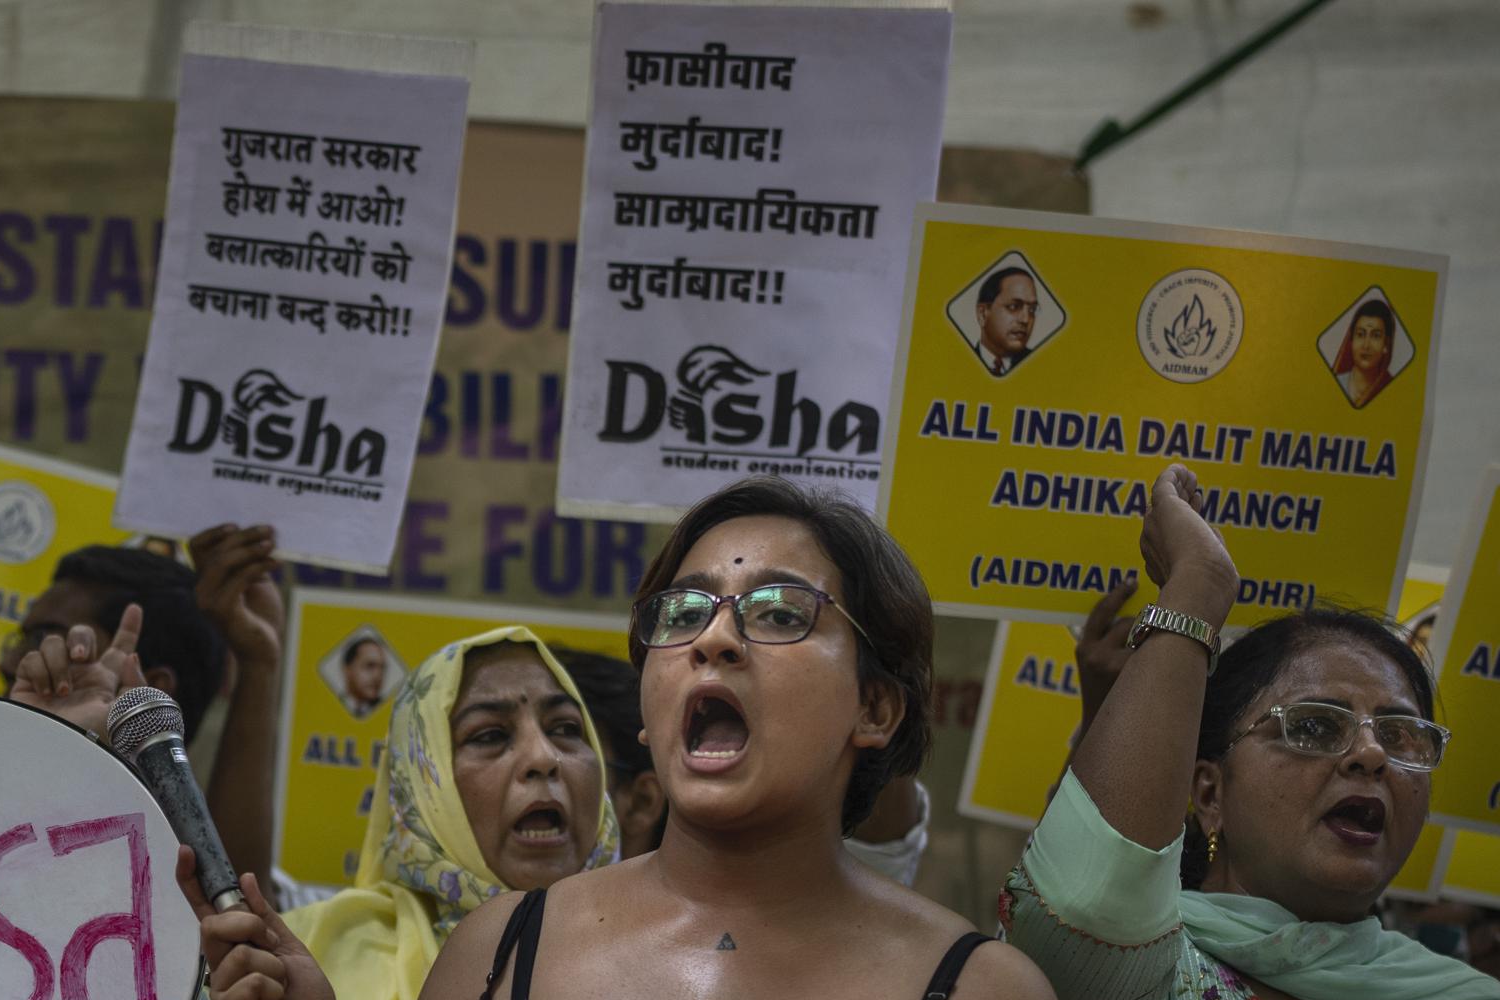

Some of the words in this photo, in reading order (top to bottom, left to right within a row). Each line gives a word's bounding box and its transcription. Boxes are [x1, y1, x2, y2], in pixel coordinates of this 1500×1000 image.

[626, 42, 795, 91] फ़ासीवाद
[221, 128, 316, 168] गुजरात
[323, 137, 421, 173] सरकार
[620, 117, 783, 171] मुर्दाबाद!
[223, 172, 280, 215] होश
[287, 177, 311, 217] में
[318, 187, 404, 226] आओ!
[614, 189, 879, 239] साम्प्रदायिकता
[205, 232, 365, 277] बलात्कारियों
[372, 242, 411, 282] को
[607, 257, 785, 310] मुर्दाबाद!!
[189, 285, 269, 320] बचाना
[277, 296, 328, 333] बन्द
[336, 295, 411, 336] करो!!
[167, 370, 386, 477] Disha
[597, 345, 880, 456] Disha
[921, 402, 998, 441] ALL
[1012, 409, 1125, 453] INDIA
[1138, 420, 1252, 463] DALIT
[1261, 431, 1397, 478] MAHILA
[662, 453, 739, 472] student
[748, 459, 880, 481] organisation
[992, 472, 1150, 517] ADHIKA
[1198, 489, 1321, 533] MANCH
[483, 504, 644, 597] FOR
[1016, 655, 1079, 695] ALL
[304, 735, 361, 768] ALL
